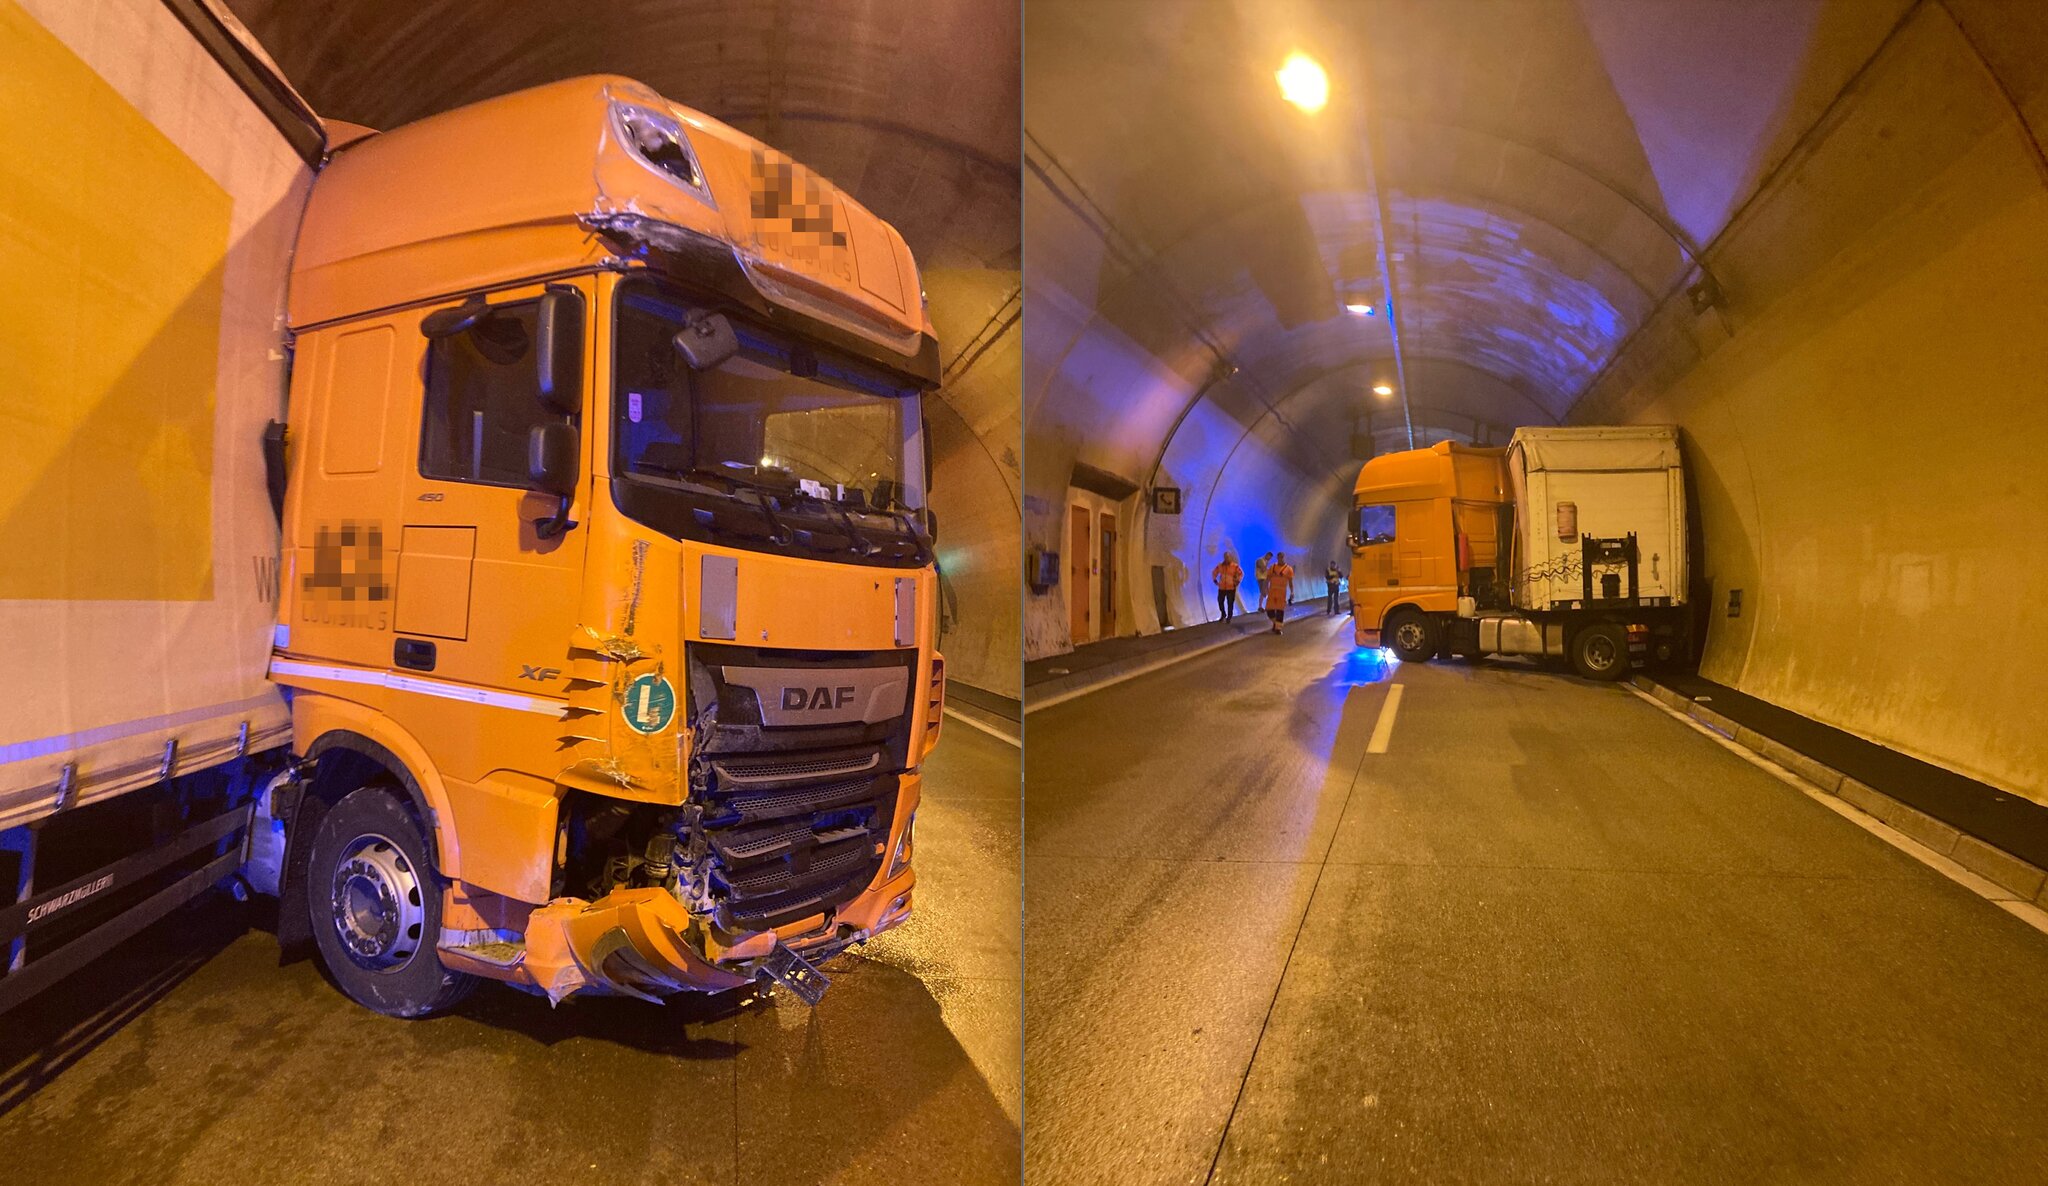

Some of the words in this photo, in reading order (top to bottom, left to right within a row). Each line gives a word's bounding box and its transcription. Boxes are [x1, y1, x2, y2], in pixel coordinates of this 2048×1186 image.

[417, 493, 444, 502] 450
[518, 664, 561, 681] XF
[636, 684, 661, 724] L
[781, 686, 856, 710] DAF
